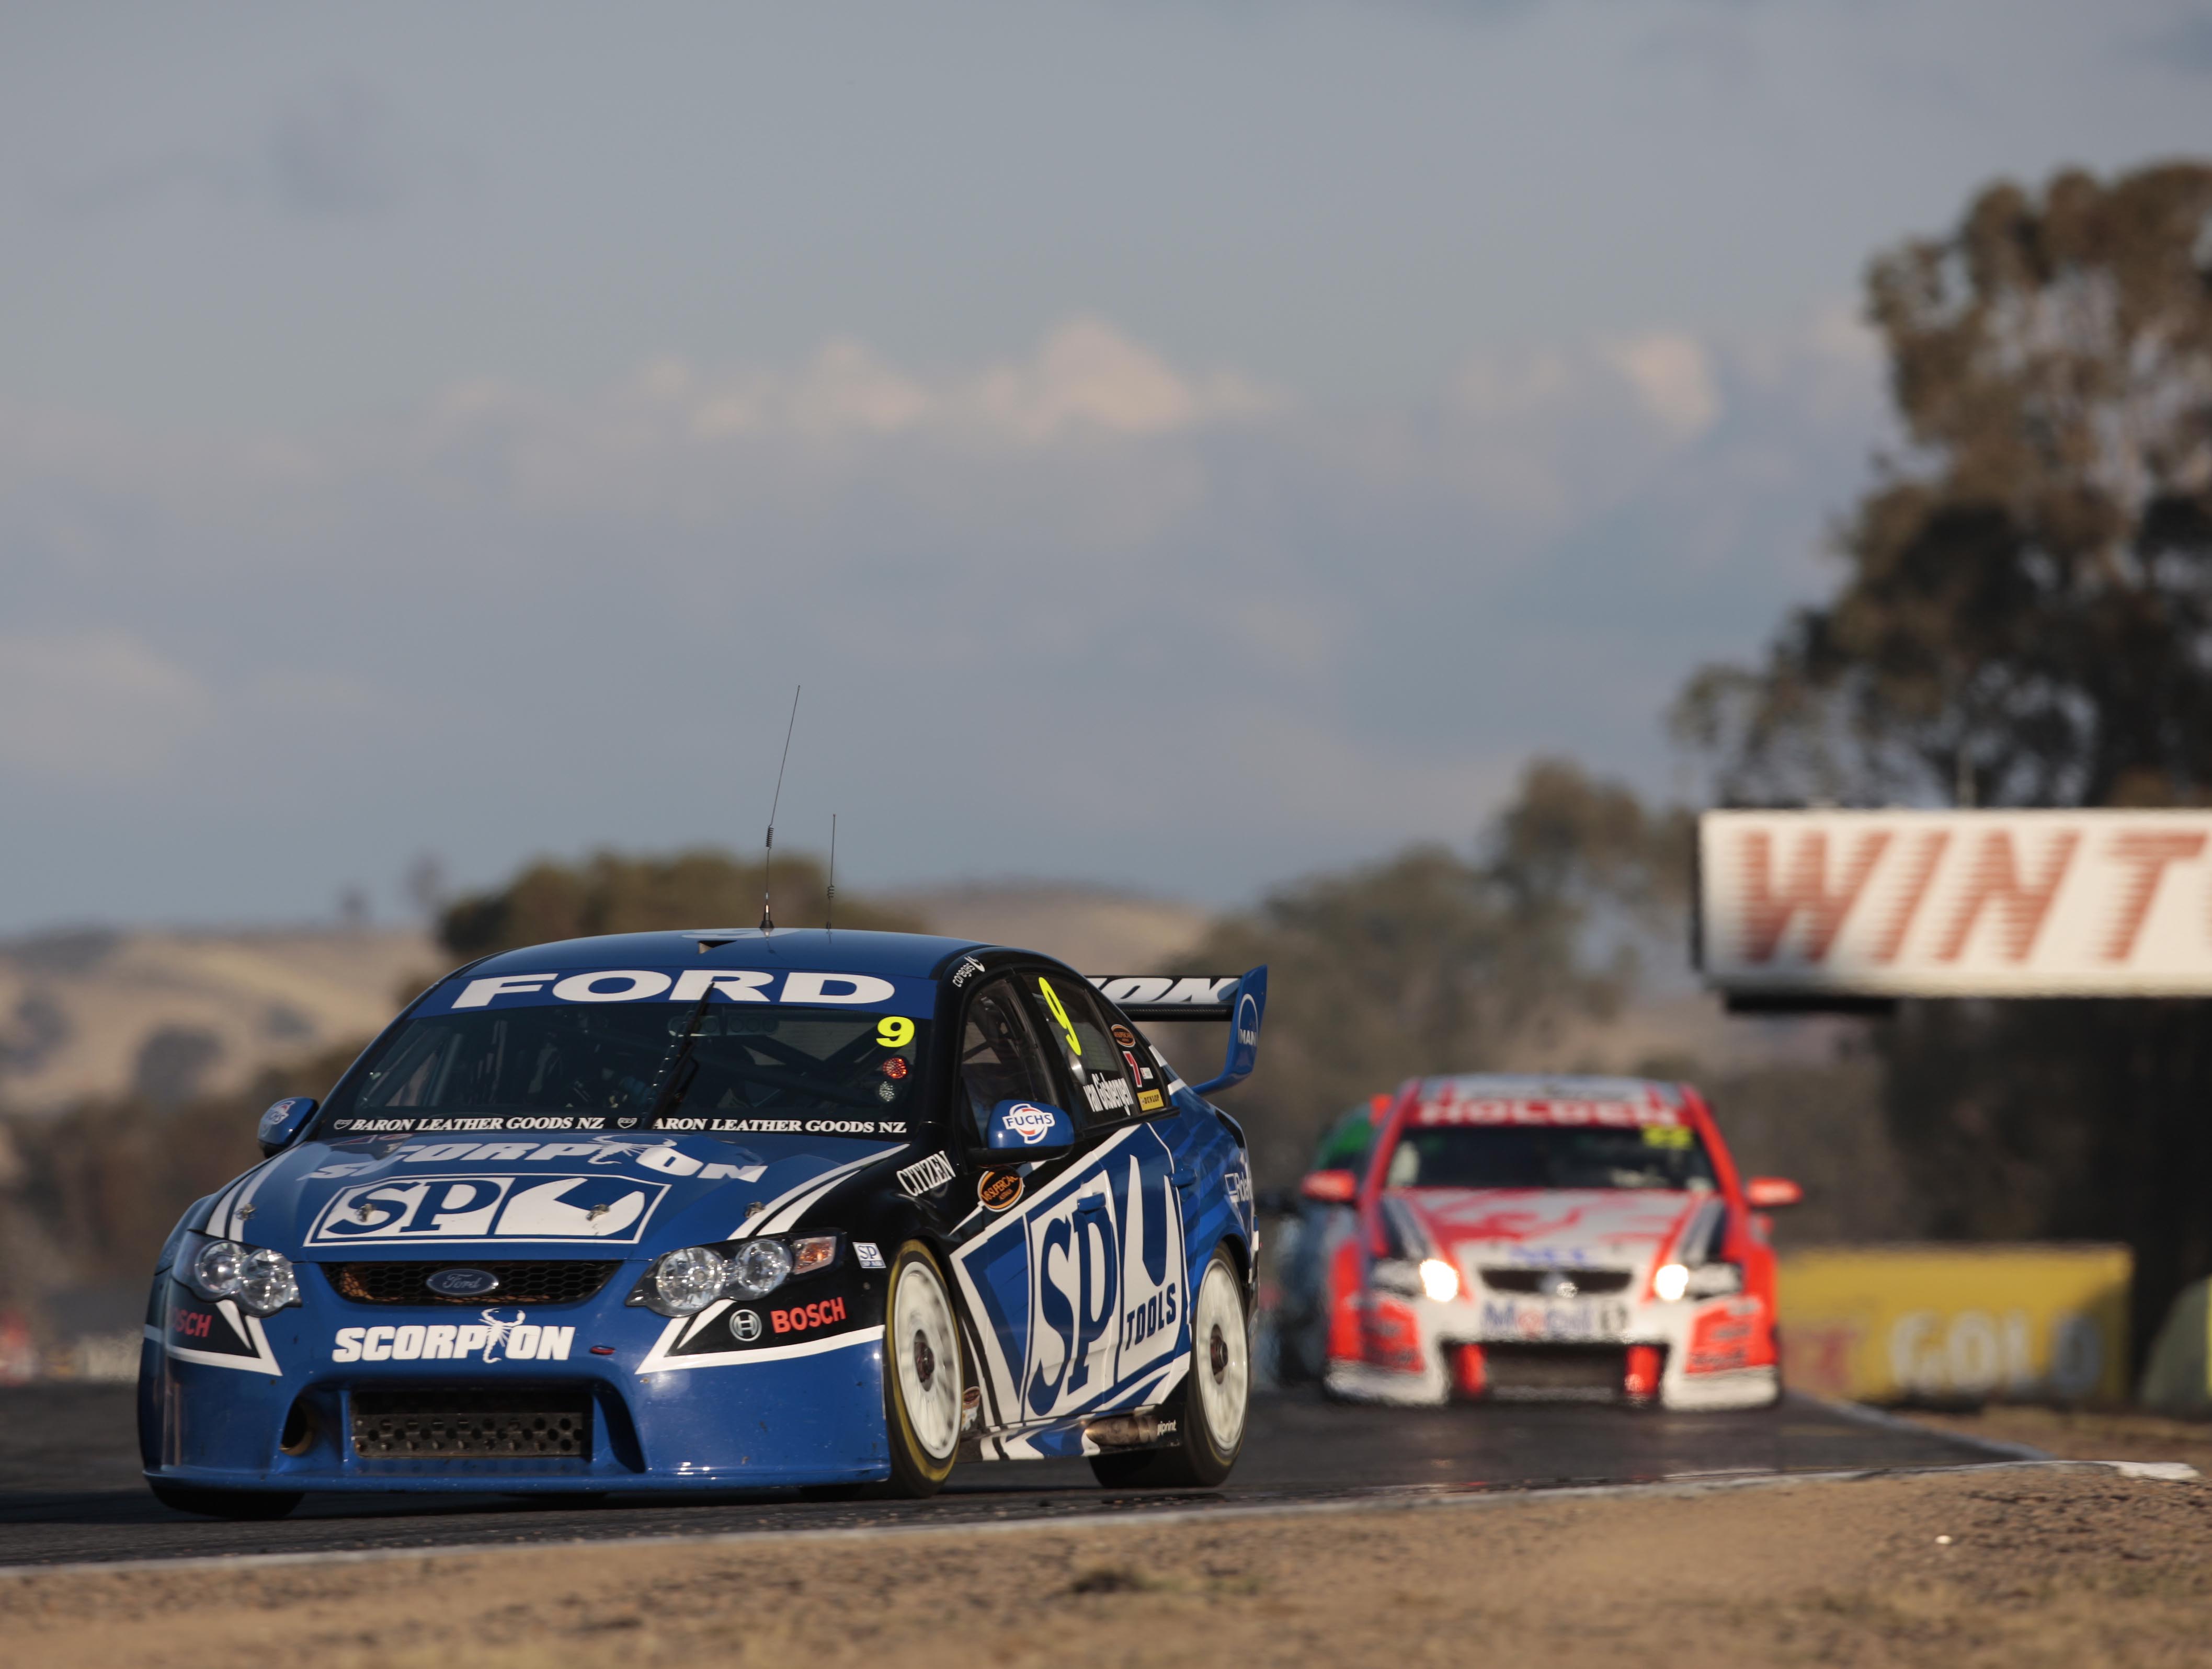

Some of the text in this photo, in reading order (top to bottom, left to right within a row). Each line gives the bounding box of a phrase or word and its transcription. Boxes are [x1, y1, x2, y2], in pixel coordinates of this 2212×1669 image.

[1740, 829, 2212, 965] WINT
[451, 970, 895, 1009] FORD
[876, 1016, 915, 1047] 9
[1038, 977, 1081, 1056] 9
[1238, 1028, 1257, 1046] MAN
[349, 1117, 606, 1130] BARON LEATHER GOODS NZ
[653, 1117, 907, 1134] ARON LEATHER GOODS NZ
[1006, 1113, 1053, 1127] FUCHS
[896, 1151, 956, 1197] CITIZEN
[858, 1245, 877, 1259] SP
[442, 1274, 482, 1288] Ford
[771, 1297, 846, 1334] BOSCH
[1125, 1283, 1177, 1351] TOOLS
